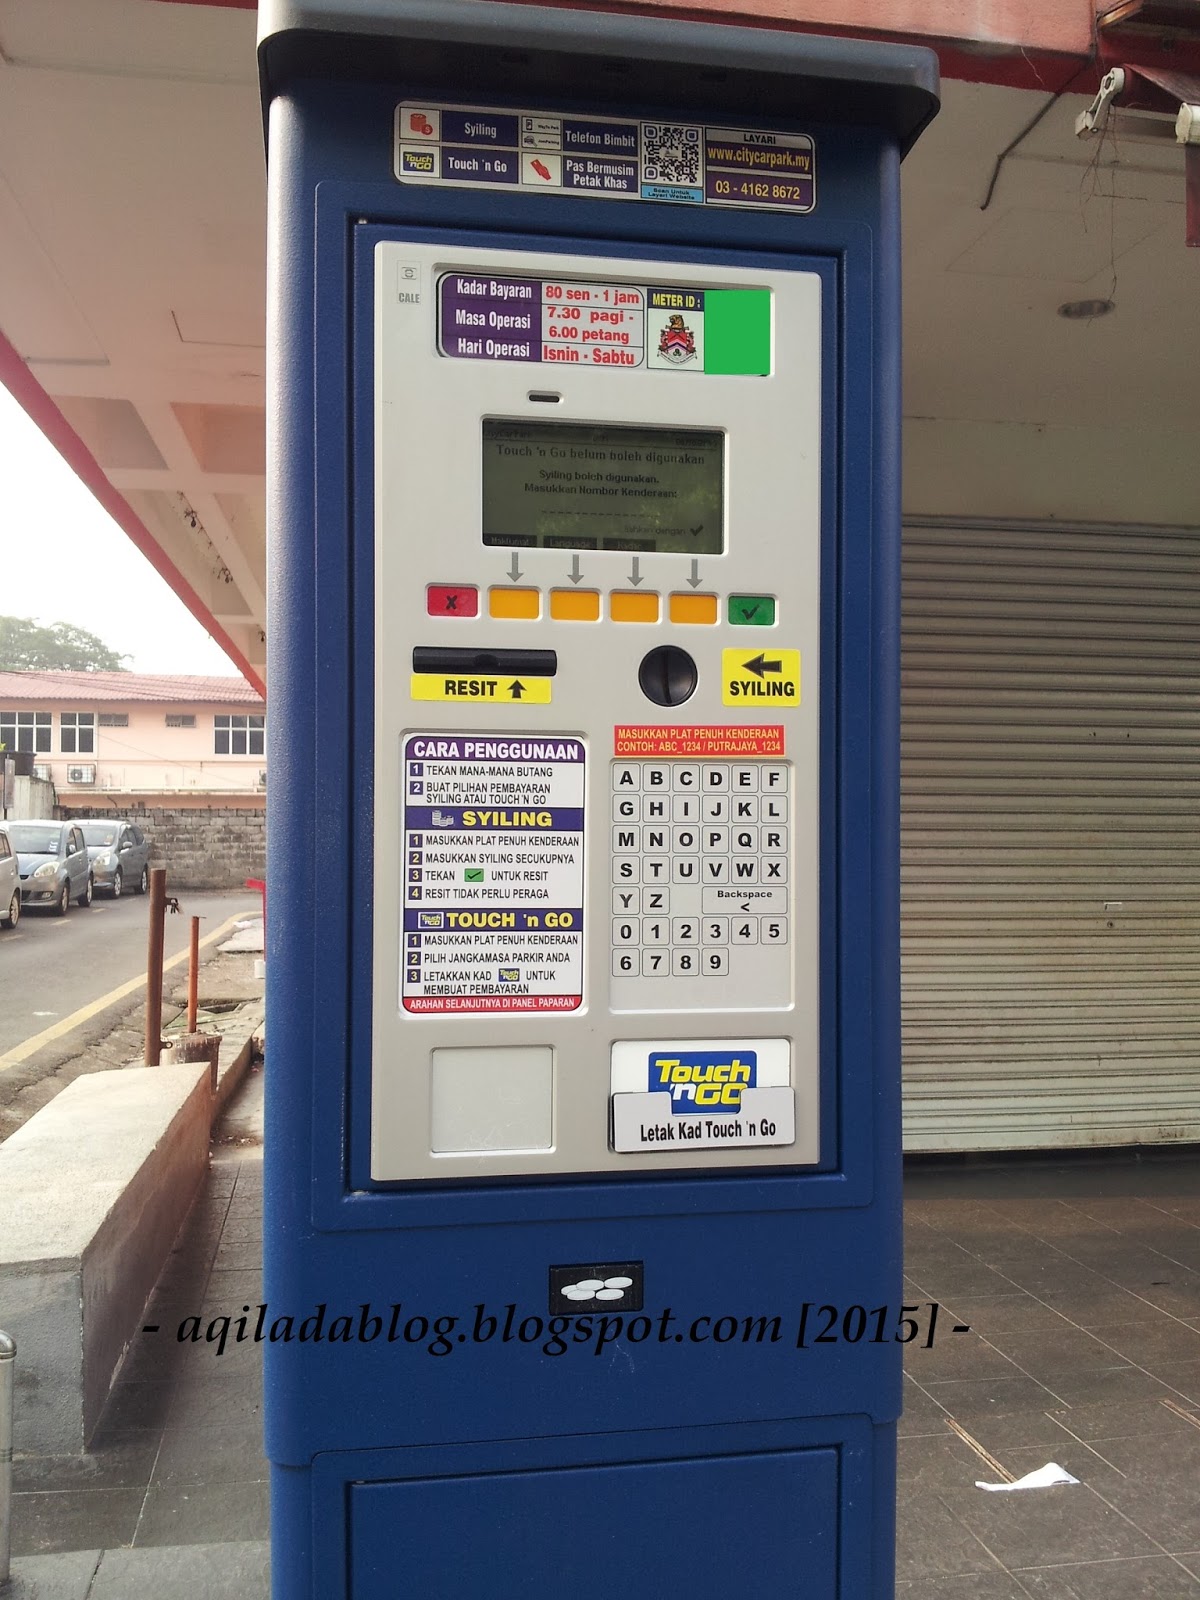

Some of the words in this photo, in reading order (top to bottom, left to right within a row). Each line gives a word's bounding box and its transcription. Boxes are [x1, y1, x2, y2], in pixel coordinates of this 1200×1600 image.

[464, 122, 497, 138] Syiling
[565, 131, 601, 144] Telefon
[604, 132, 635, 147] Bimbit
[743, 134, 776, 144] LAYARI
[405, 153, 432, 164] Touch
[448, 157, 479, 170] Touch
[494, 159, 507, 172] Go
[707, 146, 810, 170] www.citycarpark.my
[566, 160, 584, 172] Pas
[587, 161, 634, 176] Bermusim
[573, 174, 601, 187] Petak
[604, 176, 628, 189] Khas
[715, 180, 730, 193] 03
[741, 183, 769, 197] 4162
[772, 184, 800, 199] 8672
[457, 278, 488, 294] Kadar
[490, 281, 532, 300] Bayaran
[546, 286, 562, 299] 80
[566, 288, 590, 300] sen
[603, 290, 609, 301] 1
[614, 290, 639, 306] jam
[398, 293, 420, 303] CALE
[652, 293, 682, 307] METER
[455, 309, 486, 326] Masa
[489, 311, 531, 330] Operasi
[547, 306, 581, 319] 7.30
[590, 309, 624, 324] pagi
[549, 326, 578, 339] 6.00
[582, 329, 630, 344] petang
[458, 338, 482, 354] Hari
[485, 339, 530, 358] Operasi
[543, 345, 579, 361] Isnin
[592, 347, 634, 365] Sabtu
[496, 444, 532, 457] Touch
[550, 446, 566, 458] Go
[570, 448, 606, 460] belum
[609, 450, 642, 462] boleh
[645, 453, 705, 466] digunakan
[539, 470, 572, 482] Syiling
[524, 483, 577, 495] Masukkan
[579, 484, 619, 496] Nombor
[444, 680, 497, 696] RESIT
[729, 681, 795, 697] SYILING
[618, 728, 668, 739] MASUKKAN
[670, 729, 692, 738] PLAT
[694, 729, 723, 738] PENUH
[726, 729, 779, 738] KENDERAAN
[413, 741, 459, 757] CARA
[464, 742, 578, 759] PENGGUNAAN
[617, 741, 657, 751] CONTOH:
[658, 741, 700, 753] ABC_1234
[707, 741, 780, 753] PUTRAJAYA_1234
[412, 765, 419, 774] 1
[427, 766, 457, 775] TEKAN
[459, 766, 514, 776] MANA-MANA
[517, 768, 553, 777] BUTANG
[619, 771, 633, 785] A
[650, 771, 663, 785] B
[679, 772, 693, 785] C
[710, 772, 722, 785] D
[739, 772, 751, 786] E
[769, 773, 779, 786] F
[412, 783, 420, 792] 2
[427, 782, 450, 792] BUAT
[453, 783, 488, 792] PILIHAN
[491, 783, 551, 793] PEMBAYARAN
[426, 794, 461, 804] SYILING
[464, 794, 486, 804] ATAU
[489, 795, 519, 804] TOUCH
[533, 795, 546, 804] GO
[619, 802, 634, 816] G
[650, 802, 663, 816] H
[684, 802, 688, 816] I
[711, 802, 722, 816] J
[738, 802, 752, 816] K
[769, 803, 779, 816] L
[462, 811, 552, 826] SYILING
[413, 835, 419, 845] 1
[426, 836, 473, 846] MASUKKAN
[476, 836, 496, 846] PLAT
[498, 837, 526, 846] PENUH
[529, 837, 579, 846] KENDERAAN
[618, 832, 634, 847] M
[650, 832, 663, 846] N
[679, 832, 693, 847] O
[710, 833, 722, 846] P
[738, 833, 752, 848] Q
[768, 833, 781, 846] R
[412, 853, 420, 863] 2
[425, 854, 476, 863] MASUKKAN
[479, 854, 513, 863] SYILING
[516, 854, 574, 864] SECUKUPNYA
[412, 870, 419, 880] 3
[425, 871, 455, 880] TEKAN
[491, 871, 521, 881] UNTUK
[523, 871, 548, 881] RESIT
[411, 888, 419, 897] 4
[425, 889, 451, 898] RESIT
[453, 889, 480, 898] TIDAK
[482, 889, 510, 898] PERLU
[512, 889, 549, 899] PERAGA
[717, 890, 772, 899] Backspace
[446, 912, 515, 927] TOUCH
[523, 913, 538, 927] 'n
[544, 913, 573, 927] GO
[412, 935, 417, 945] 1
[424, 935, 472, 945] MASUKKAN
[474, 935, 495, 945] PLAT
[497, 935, 525, 944] PENUH
[528, 935, 578, 944] KENDERAAN
[411, 953, 418, 963] 2
[424, 954, 446, 963] PILIH
[449, 953, 510, 963] JANGKAMASA
[512, 953, 544, 962] PARKIR
[546, 953, 570, 962] ANDA
[411, 971, 418, 981] 3
[424, 971, 471, 981] LETAKKAN
[473, 971, 491, 981] KAD
[526, 971, 556, 980] UNTUK
[424, 985, 467, 994] MEMBUAT
[470, 984, 529, 994] PEMBAYARAN
[410, 999, 443, 1009] ARAHAN
[446, 999, 501, 1008] SELANJUTNYA
[503, 999, 510, 1008] DI
[512, 999, 536, 1008] PANEL
[538, 998, 574, 1007] PAPARAN
[655, 1059, 751, 1083] Touch
[640, 1123, 675, 1142] Letak
[678, 1121, 702, 1139] Kad
[705, 1120, 741, 1138] Touch
[760, 1119, 776, 1136] Go
